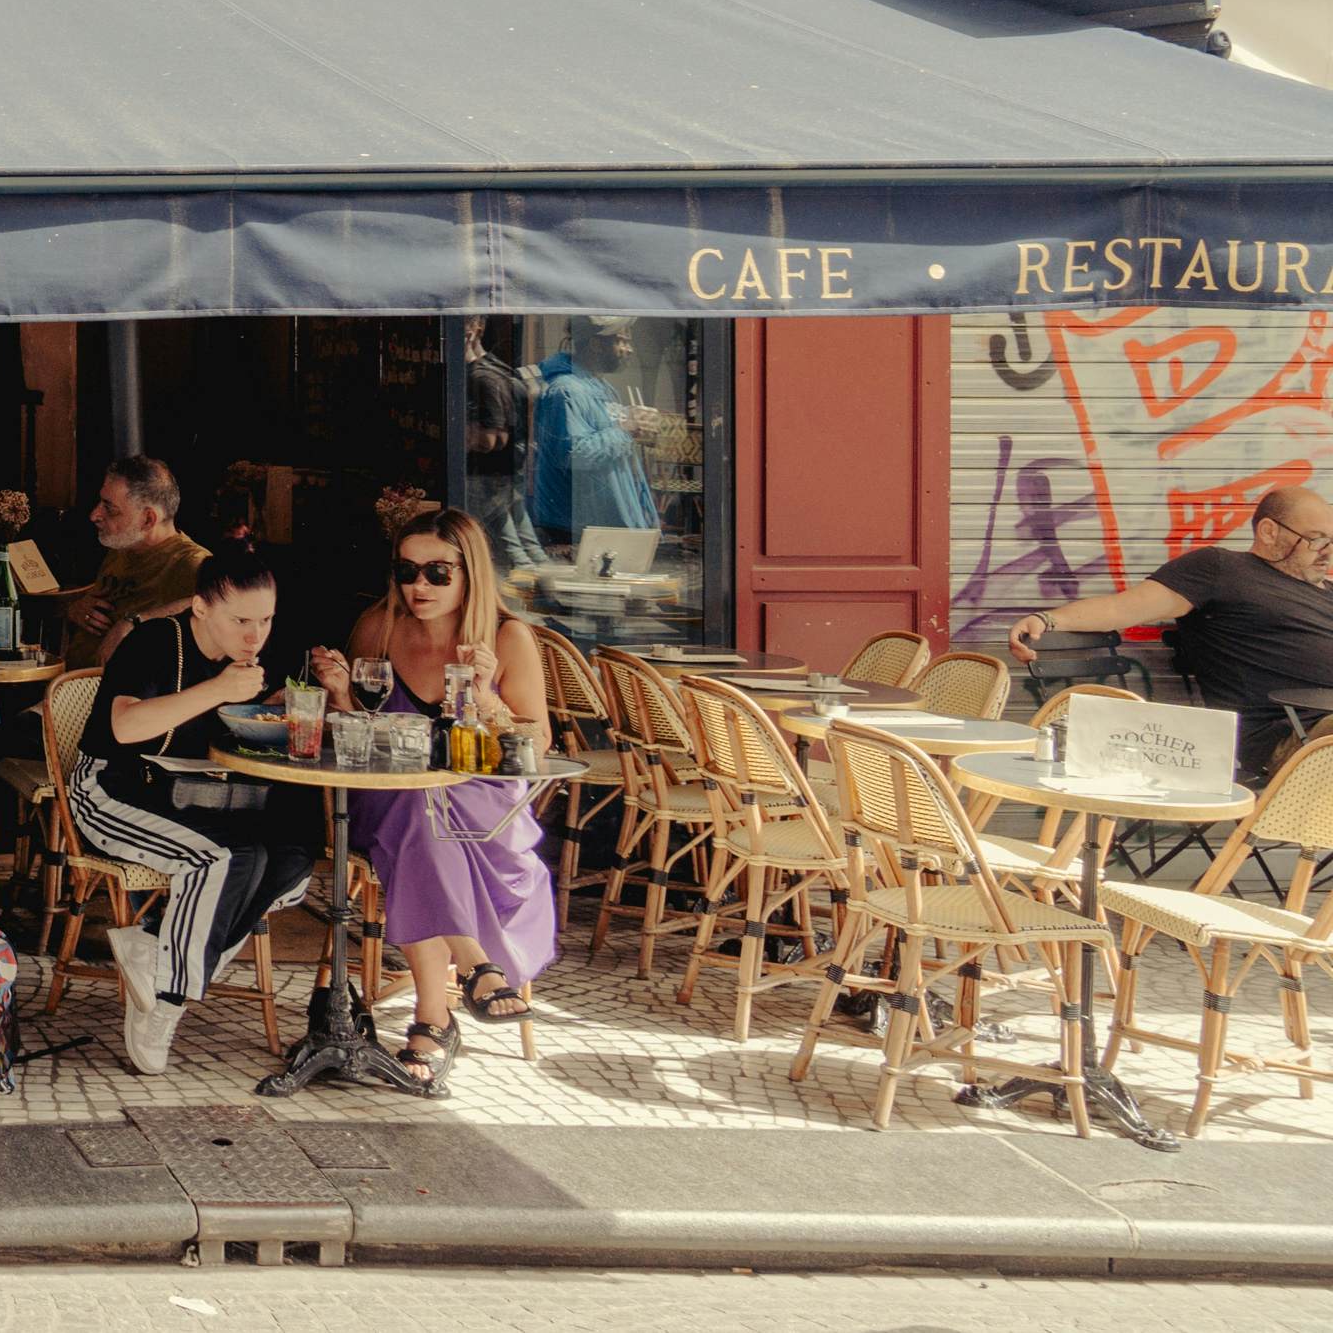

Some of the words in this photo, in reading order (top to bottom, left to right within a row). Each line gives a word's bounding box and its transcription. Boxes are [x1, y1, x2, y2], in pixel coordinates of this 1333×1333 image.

[689, 247, 853, 301] CAFE
[1143, 722, 1163, 732] AU
[1141, 750, 1203, 770] NCALE
